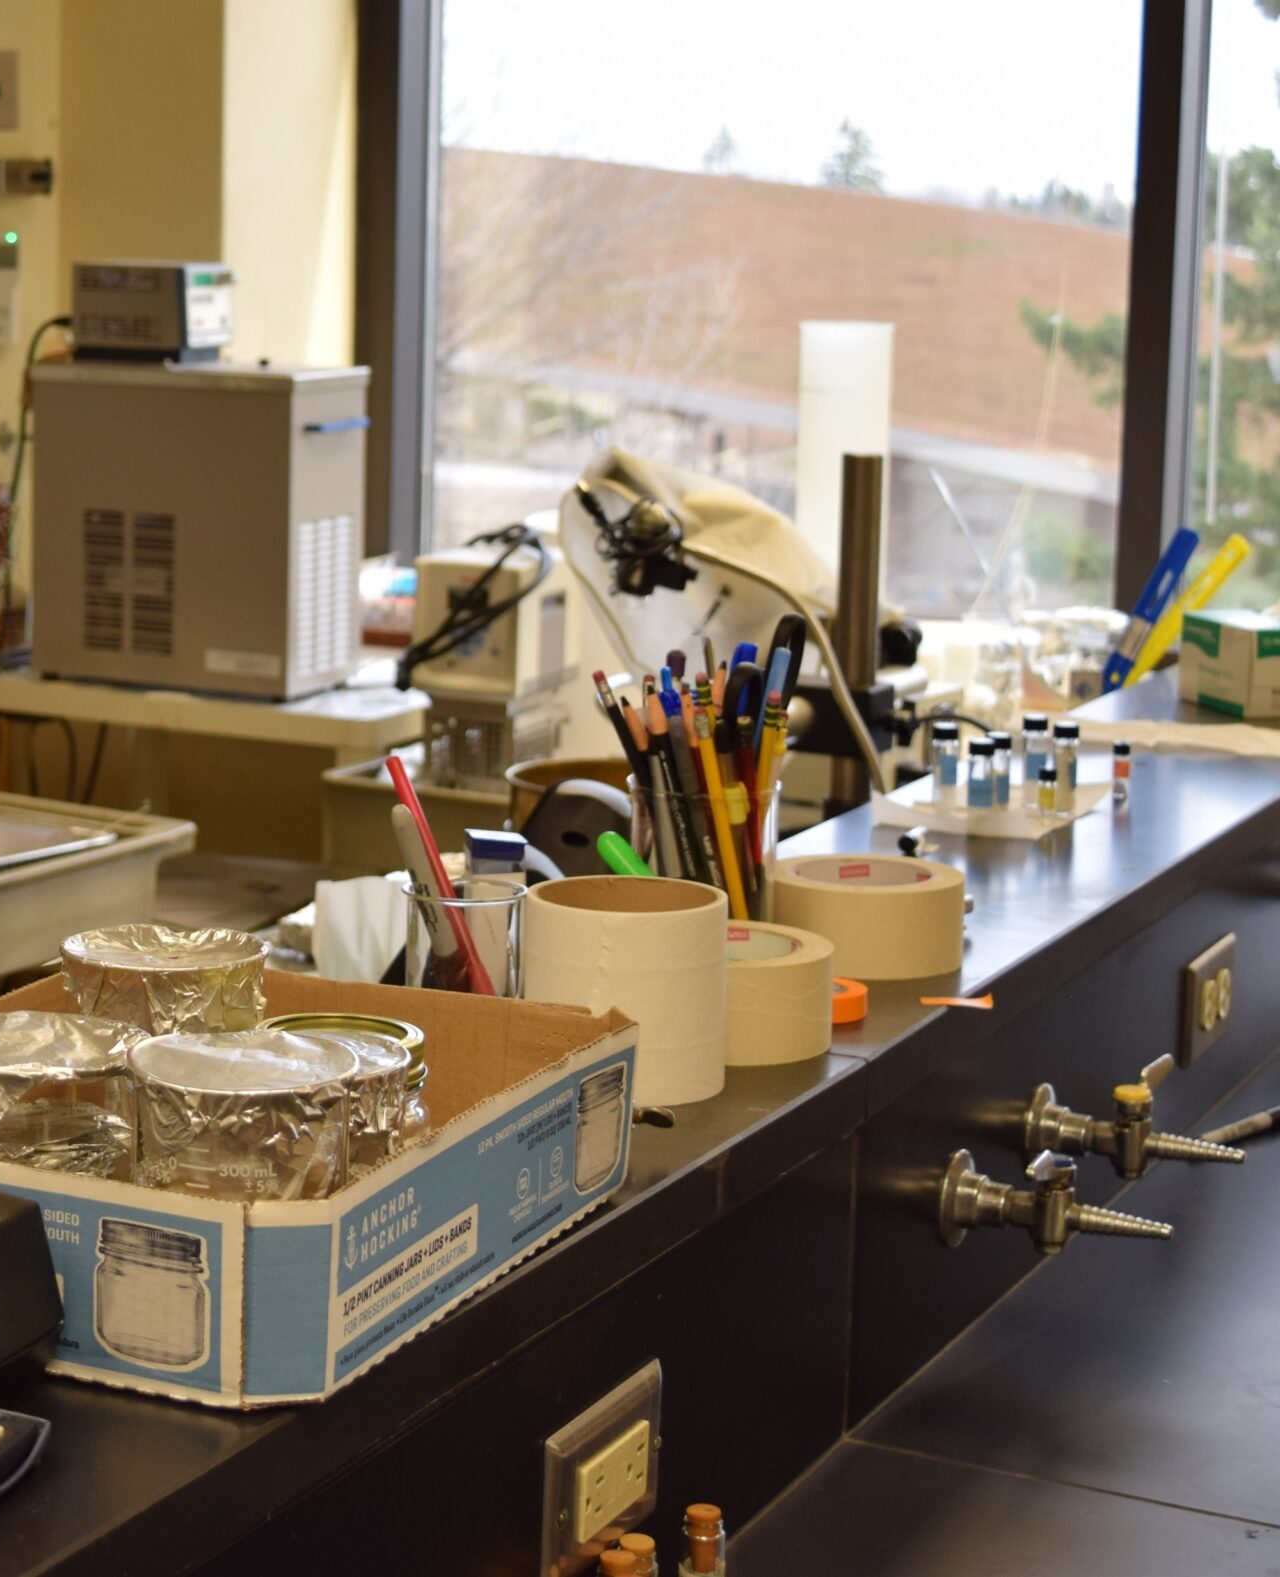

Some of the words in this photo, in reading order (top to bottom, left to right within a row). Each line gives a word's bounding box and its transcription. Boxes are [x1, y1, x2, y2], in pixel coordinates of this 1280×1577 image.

[219, 1163, 250, 1177] 300
[254, 1163, 277, 1178] mL
[256, 1180, 278, 1192] 5%
[44, 1209, 80, 1226] SIDED
[361, 1186, 415, 1237] ANCHOR
[45, 1227, 80, 1245] OUTH
[343, 1295, 356, 1317] 1/2
[356, 1285, 374, 1308] PINT
[373, 1266, 404, 1295] CANNING
[404, 1252, 423, 1277] JARS
[428, 1237, 444, 1257] LIDS
[449, 1217, 472, 1243] BANDS
[344, 1317, 359, 1338] FOR
[359, 1291, 401, 1327] PRESERVING
[402, 1272, 420, 1296] FOOD
[421, 1264, 436, 1282] AND
[436, 1241, 468, 1271] CRAFTING
